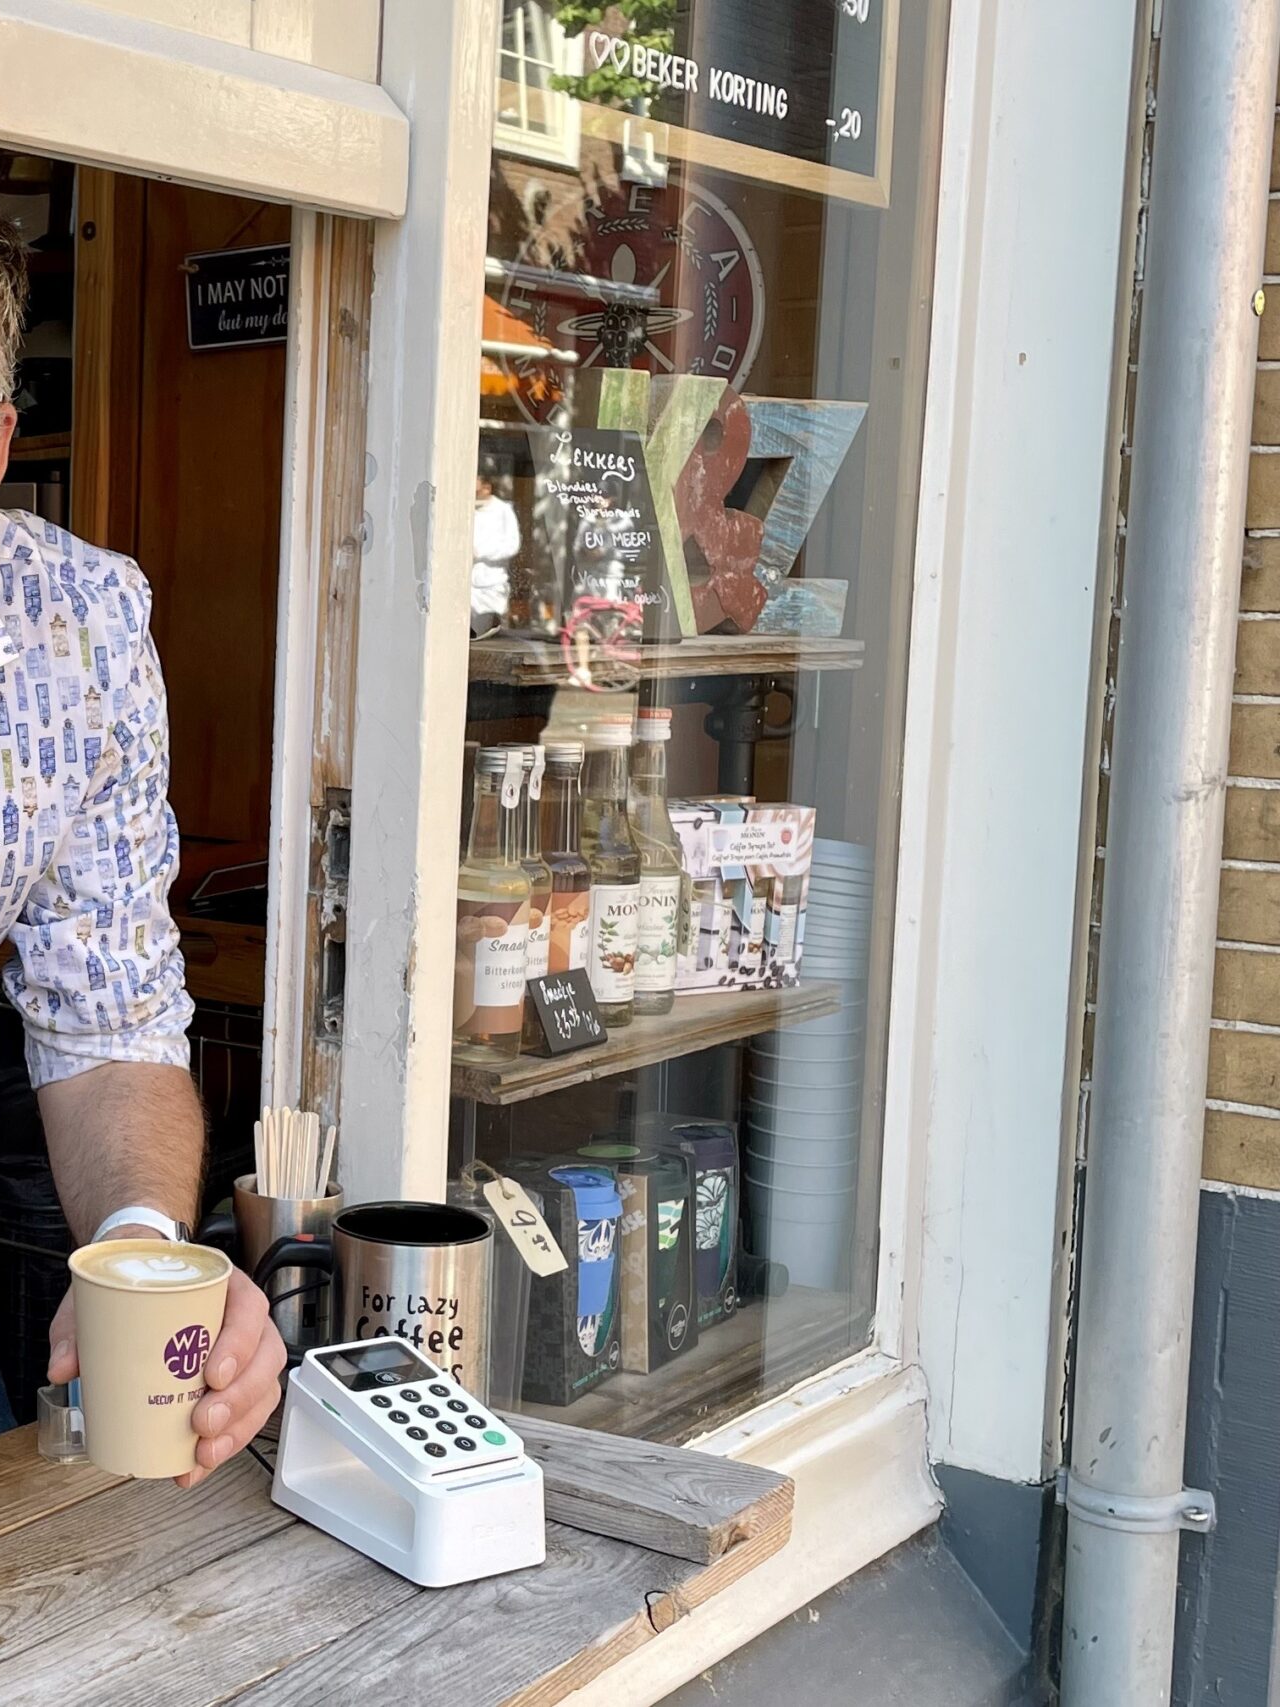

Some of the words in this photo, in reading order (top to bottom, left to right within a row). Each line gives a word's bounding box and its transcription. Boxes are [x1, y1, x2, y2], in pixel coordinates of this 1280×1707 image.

[632, 45, 699, 93] BEKER
[709, 67, 788, 119] KORTING
[197, 284, 202, 306] I
[208, 279, 245, 304] MAY
[250, 274, 287, 300] NOT
[218, 309, 242, 331] but
[245, 314, 269, 334] my
[585, 532, 604, 548] EN
[612, 531, 651, 549] MEER!
[638, 895, 677, 908] ONIN
[362, 1285, 396, 1313] For
[170, 1327, 209, 1352] WE
[148, 1394, 174, 1405] WECUP
[177, 1392, 185, 1404] IT
